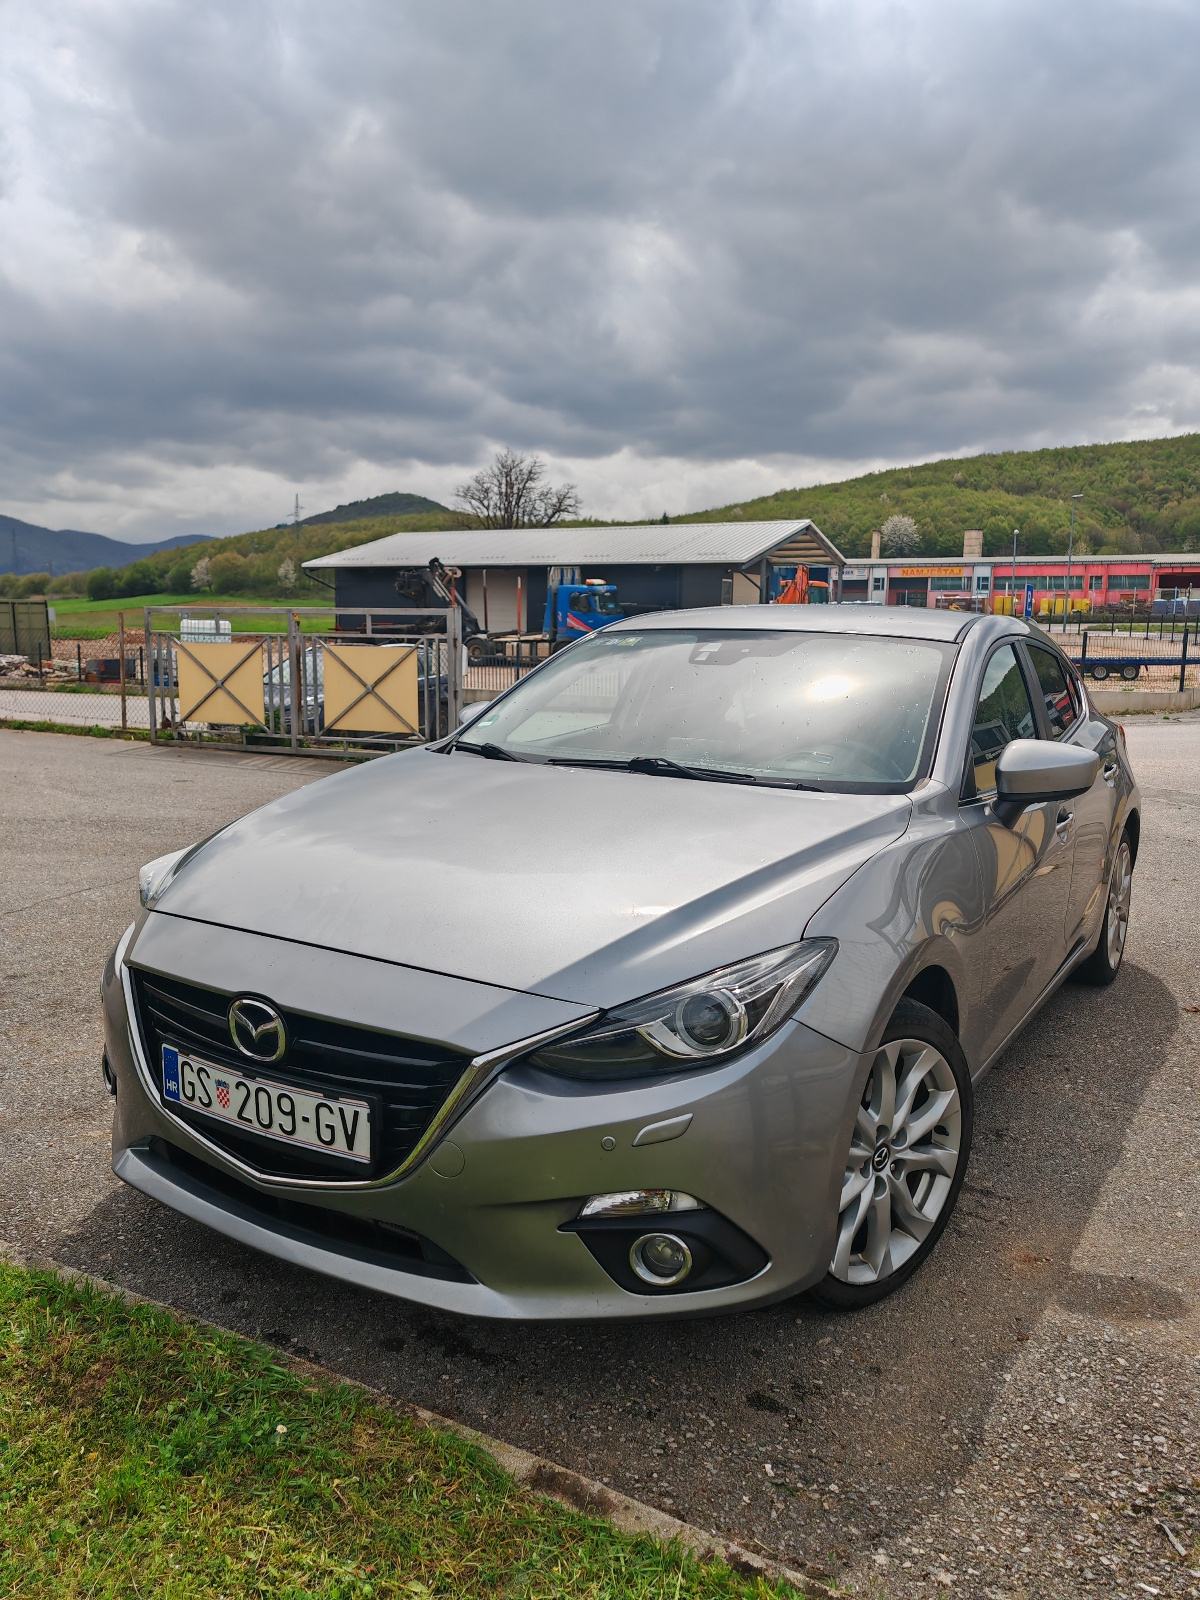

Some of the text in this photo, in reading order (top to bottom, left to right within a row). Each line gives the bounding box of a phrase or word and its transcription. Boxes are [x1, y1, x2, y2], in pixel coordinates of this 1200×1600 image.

[166, 1078, 178, 1093] HR
[181, 1060, 359, 1151] GS 209-GV
